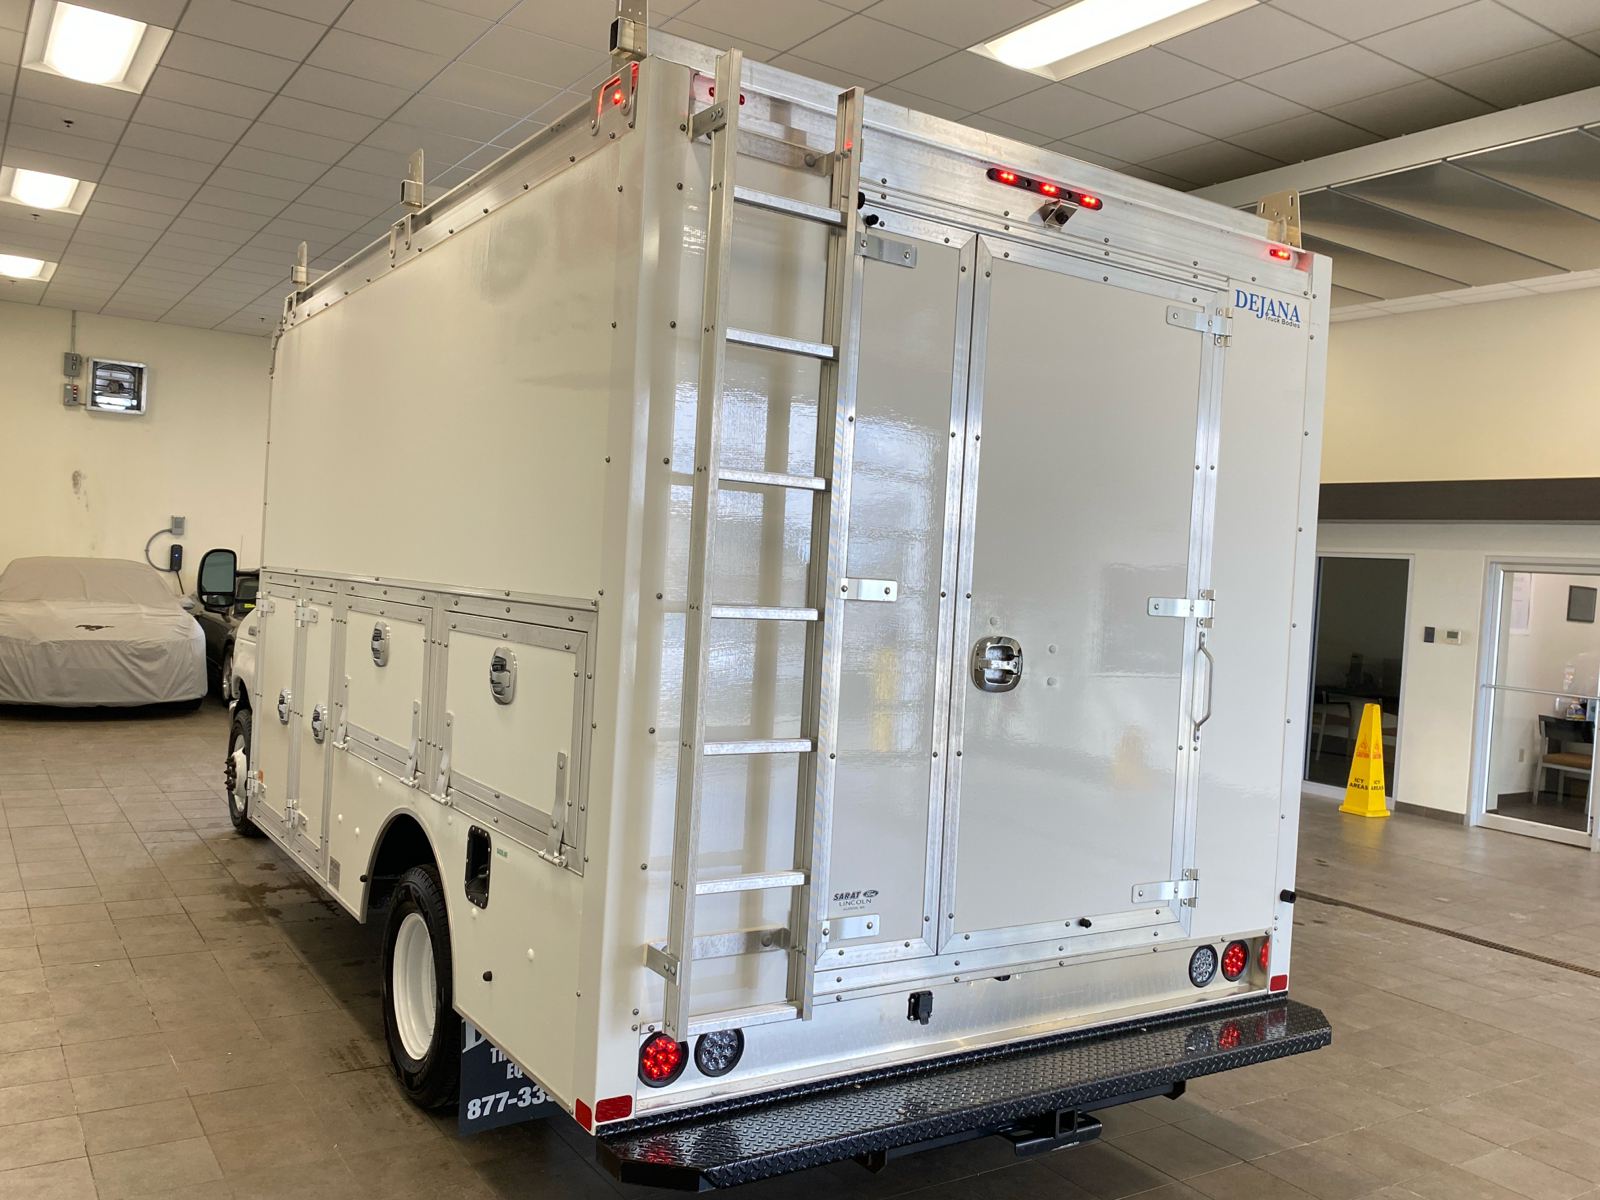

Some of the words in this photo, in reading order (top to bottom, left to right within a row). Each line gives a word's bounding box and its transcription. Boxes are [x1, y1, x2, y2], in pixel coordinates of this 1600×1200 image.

[1235, 289, 1301, 323] DEJANA
[1265, 315, 1281, 324] Truck
[1281, 319, 1301, 329] Bodies
[1349, 782, 1369, 790] AREAS
[833, 890, 862, 901] SARAT
[839, 898, 872, 907] LINCOLN
